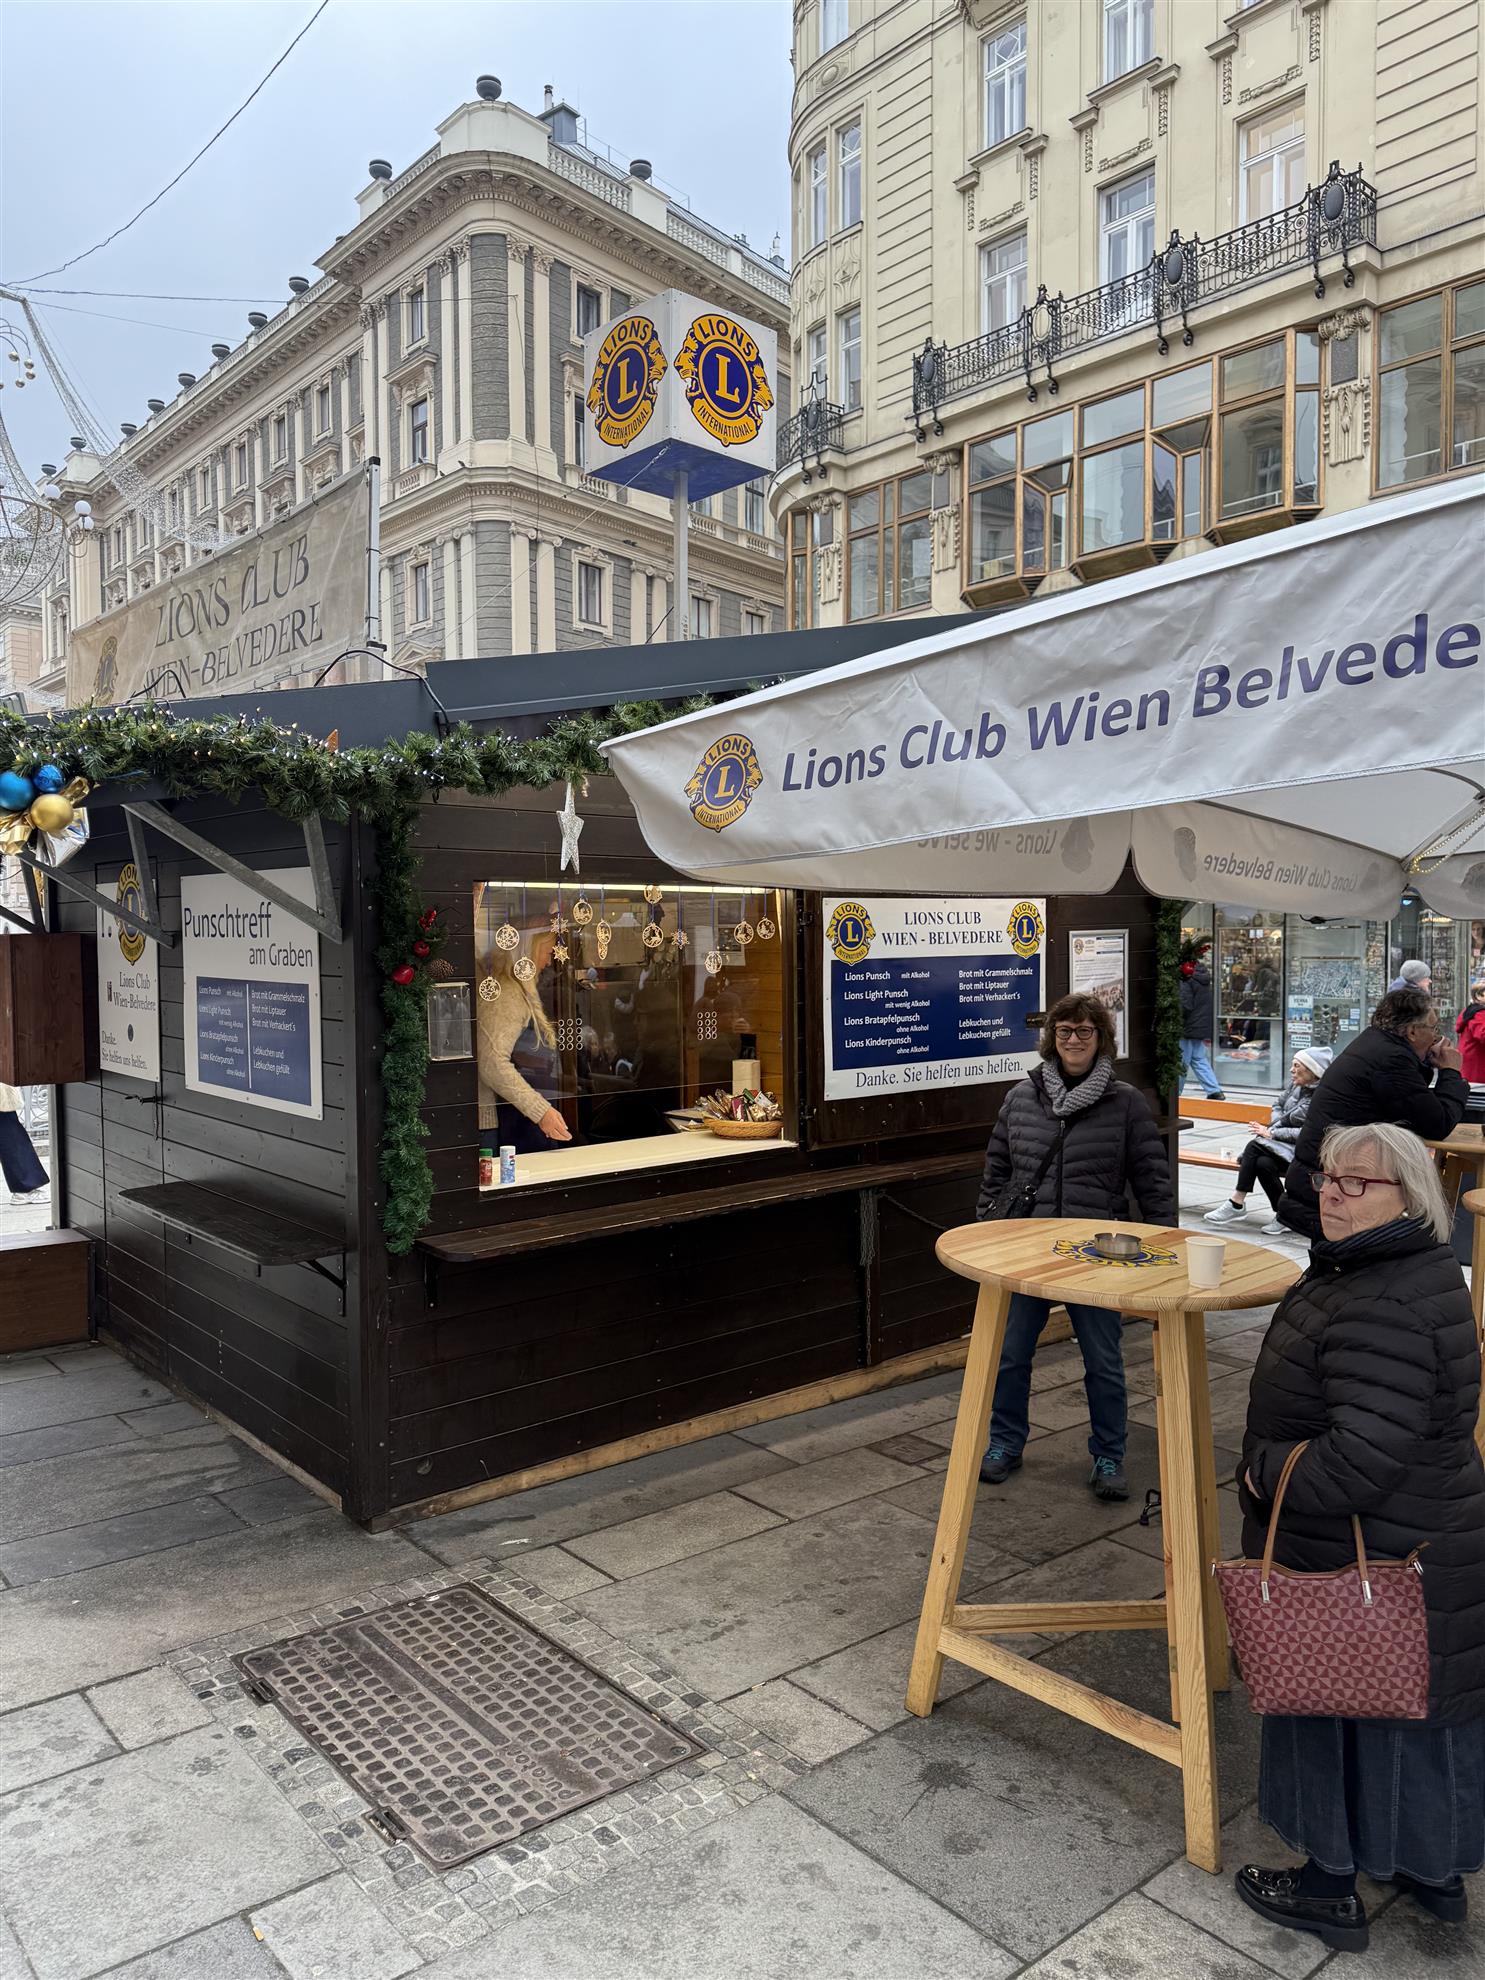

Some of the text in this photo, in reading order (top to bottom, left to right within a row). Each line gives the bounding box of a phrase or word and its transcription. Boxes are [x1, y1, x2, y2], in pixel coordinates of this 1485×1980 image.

[603, 322, 648, 358] LIONS
[697, 318, 753, 357] LIONS
[617, 357, 638, 404] L
[715, 353, 740, 404] L
[603, 407, 649, 440] INTERNATIONAL
[697, 405, 753, 438] INTERNATIONAL
[155, 533, 310, 648] LIONS CLUB
[782, 613, 1482, 792] Lions Club Wien Belvede
[708, 737, 750, 762] LIONS
[697, 804, 743, 824] INTERNATIONAL
[836, 904, 865, 917] LIONS
[1015, 903, 1036, 915] LIONS
[184, 901, 272, 939] Punschtreff
[904, 911, 981, 925] LIONS CLUB
[881, 932, 918, 946] WIEN
[928, 930, 1004, 945] BELVEDERE
[249, 941, 313, 967] am Graben
[845, 972, 864, 981] Lions
[865, 971, 890, 980] Punsch
[911, 971, 930, 979] Alkohol
[958, 967, 1033, 978] Brot mit Grammelschmalz
[959, 981, 1010, 991] Brot mit Liptauer
[844, 988, 909, 1001] Lions Light Punsch
[959, 995, 973, 1003] Brot
[973, 993, 984, 1002] mit
[884, 1001, 894, 1009] mit
[894, 1001, 911, 1009] wenig
[844, 1012, 920, 1026] Lions Bratapfelpunsch
[958, 1016, 1004, 1028] Lebkuchen und
[910, 1024, 929, 1032] Alkohol
[958, 1028, 1011, 1040] Lebkuchen gefüllt
[845, 1035, 912, 1048] Lions Kinderpunsch
[910, 1045, 929, 1053] Alkohol
[855, 1058, 1024, 1088] Danke. Sie helfen uns helfen.
